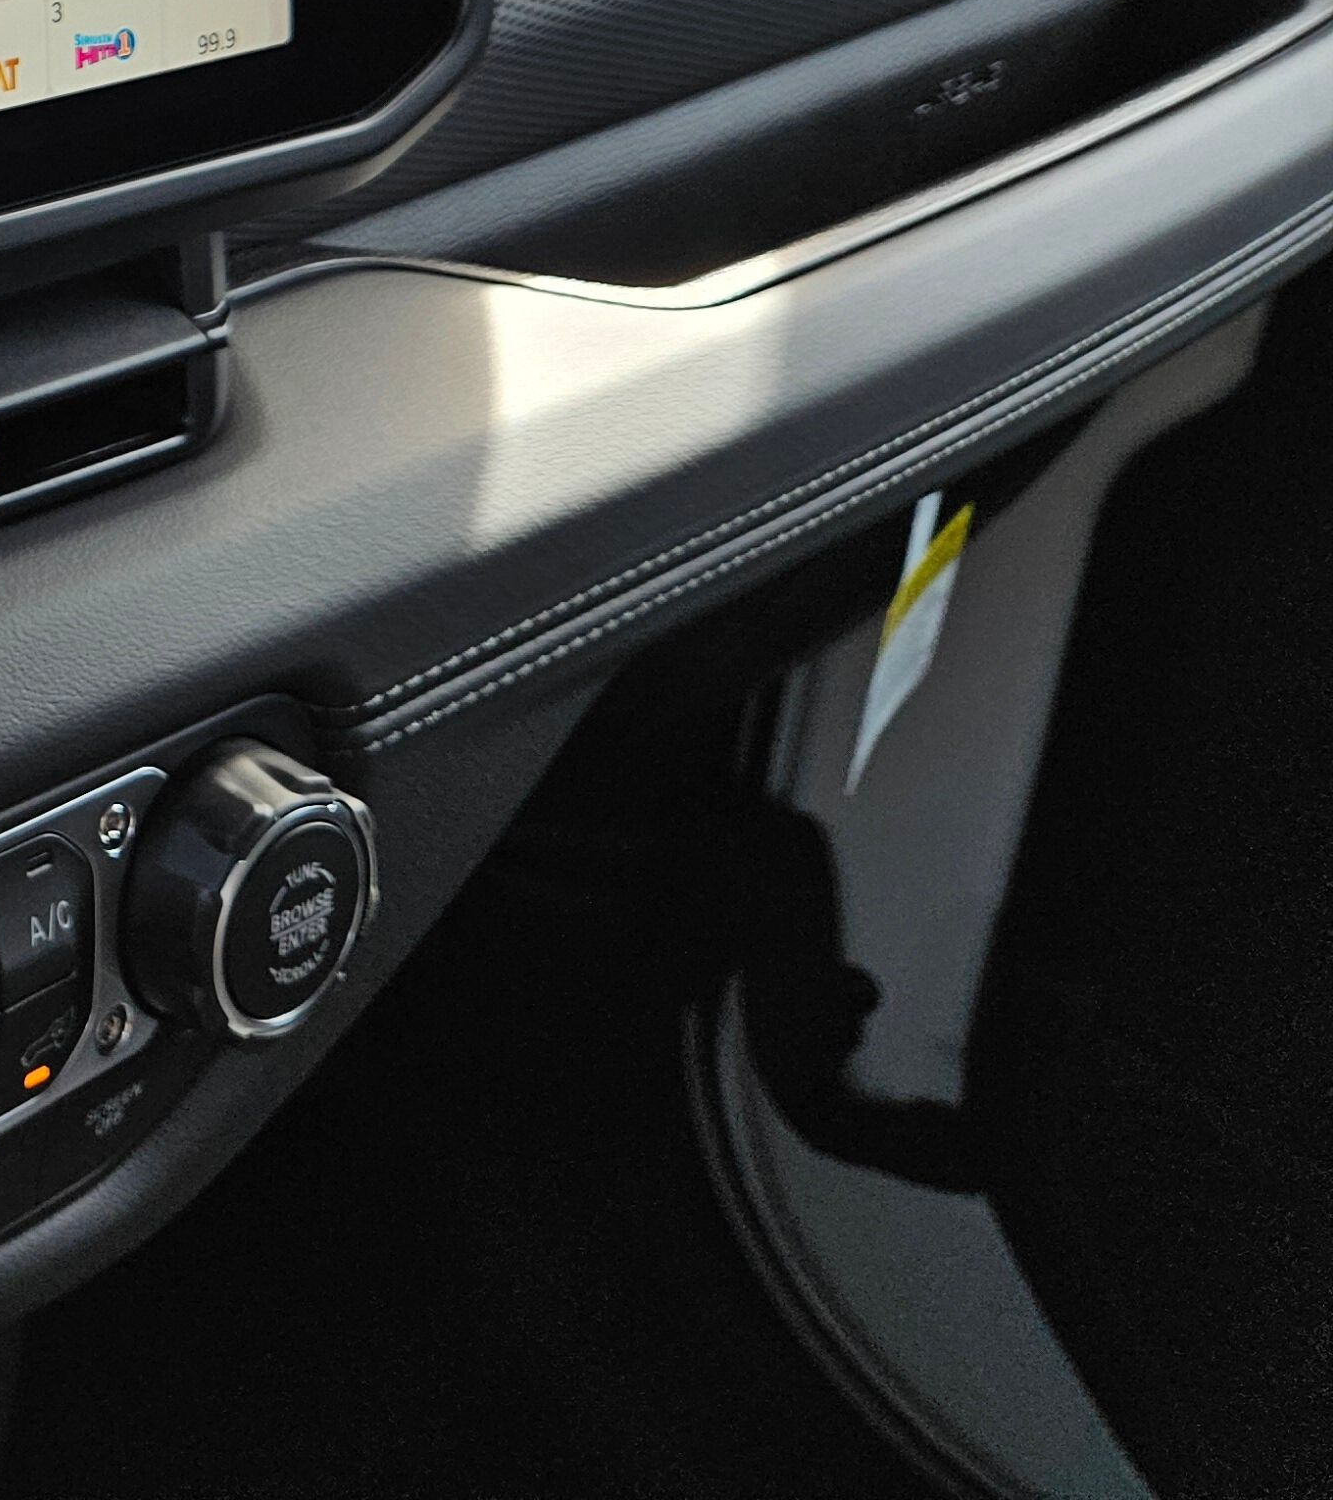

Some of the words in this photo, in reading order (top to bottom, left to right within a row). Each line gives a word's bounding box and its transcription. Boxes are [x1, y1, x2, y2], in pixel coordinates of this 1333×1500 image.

[51, 2, 63, 23] 3
[198, 29, 236, 54] 99.9
[285, 861, 322, 888] TUNE
[31, 899, 71, 946] A/C
[271, 888, 335, 932] BROWSE
[278, 917, 328, 956] ENTER
